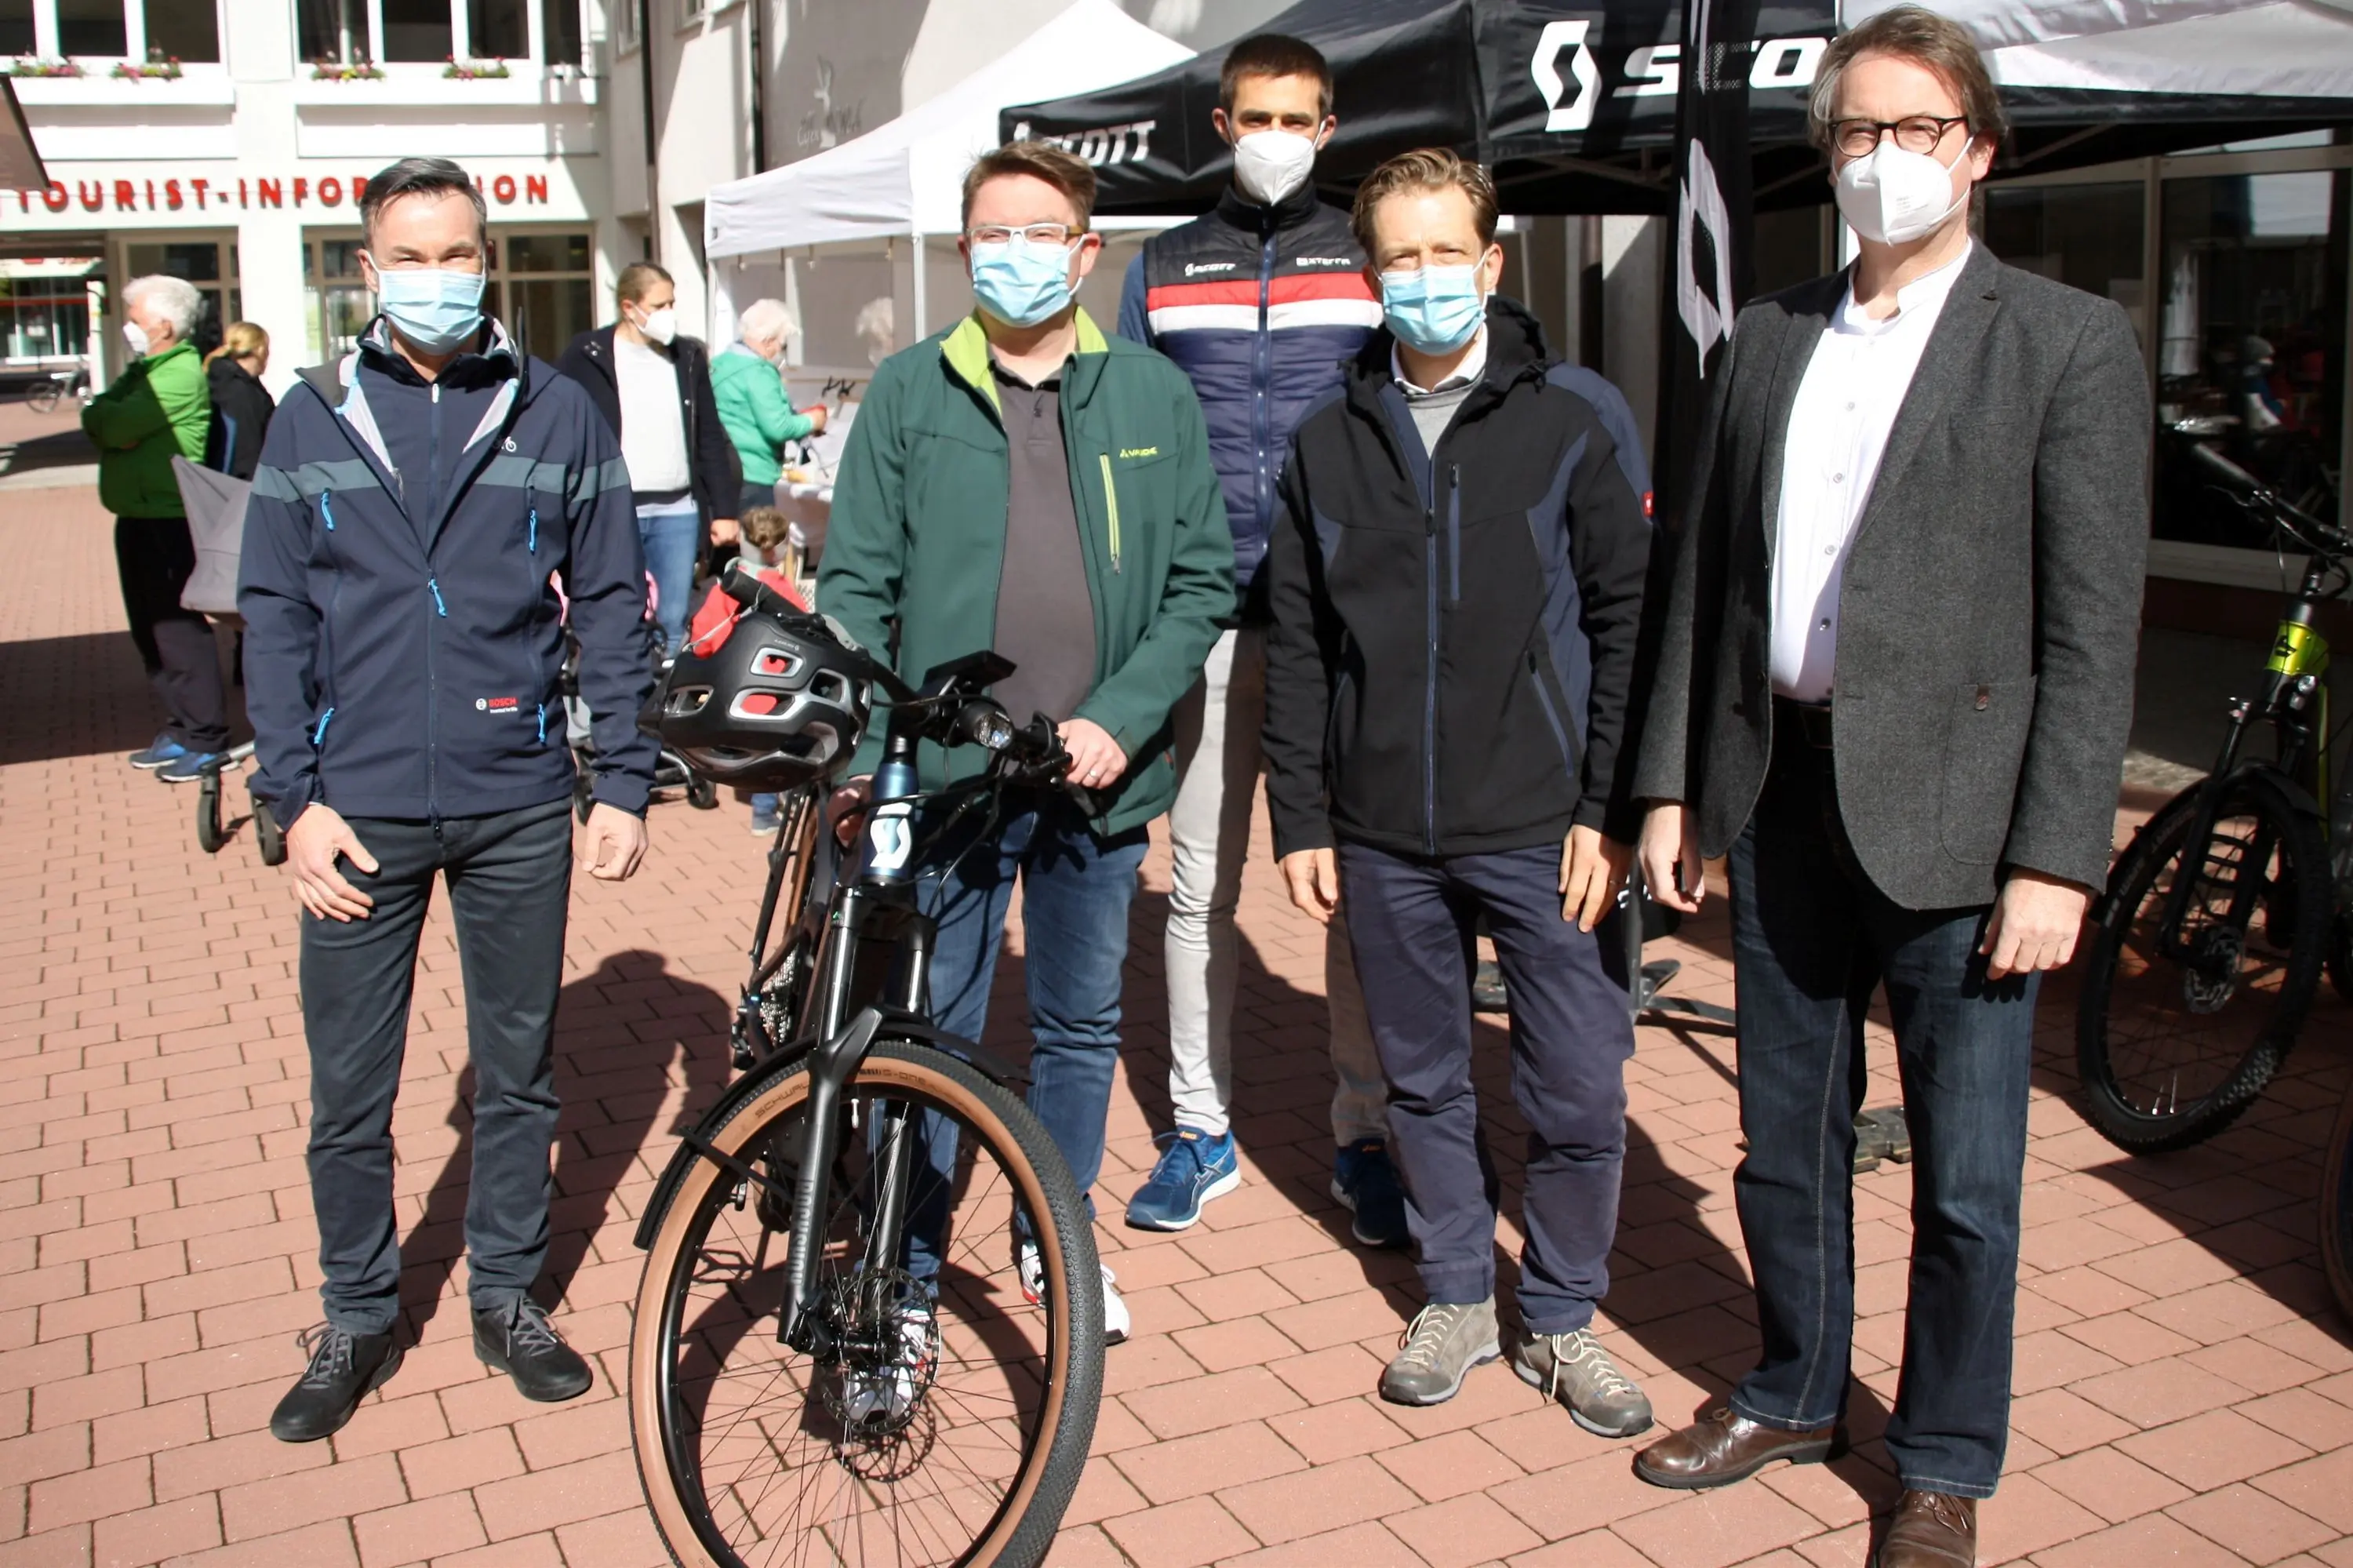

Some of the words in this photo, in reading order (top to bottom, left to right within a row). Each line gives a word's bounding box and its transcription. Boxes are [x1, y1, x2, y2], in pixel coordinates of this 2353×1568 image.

[1042, 120, 1156, 166] COTT
[488, 697, 516, 708] BOSCH
[755, 1083, 809, 1119] SCHWAL
